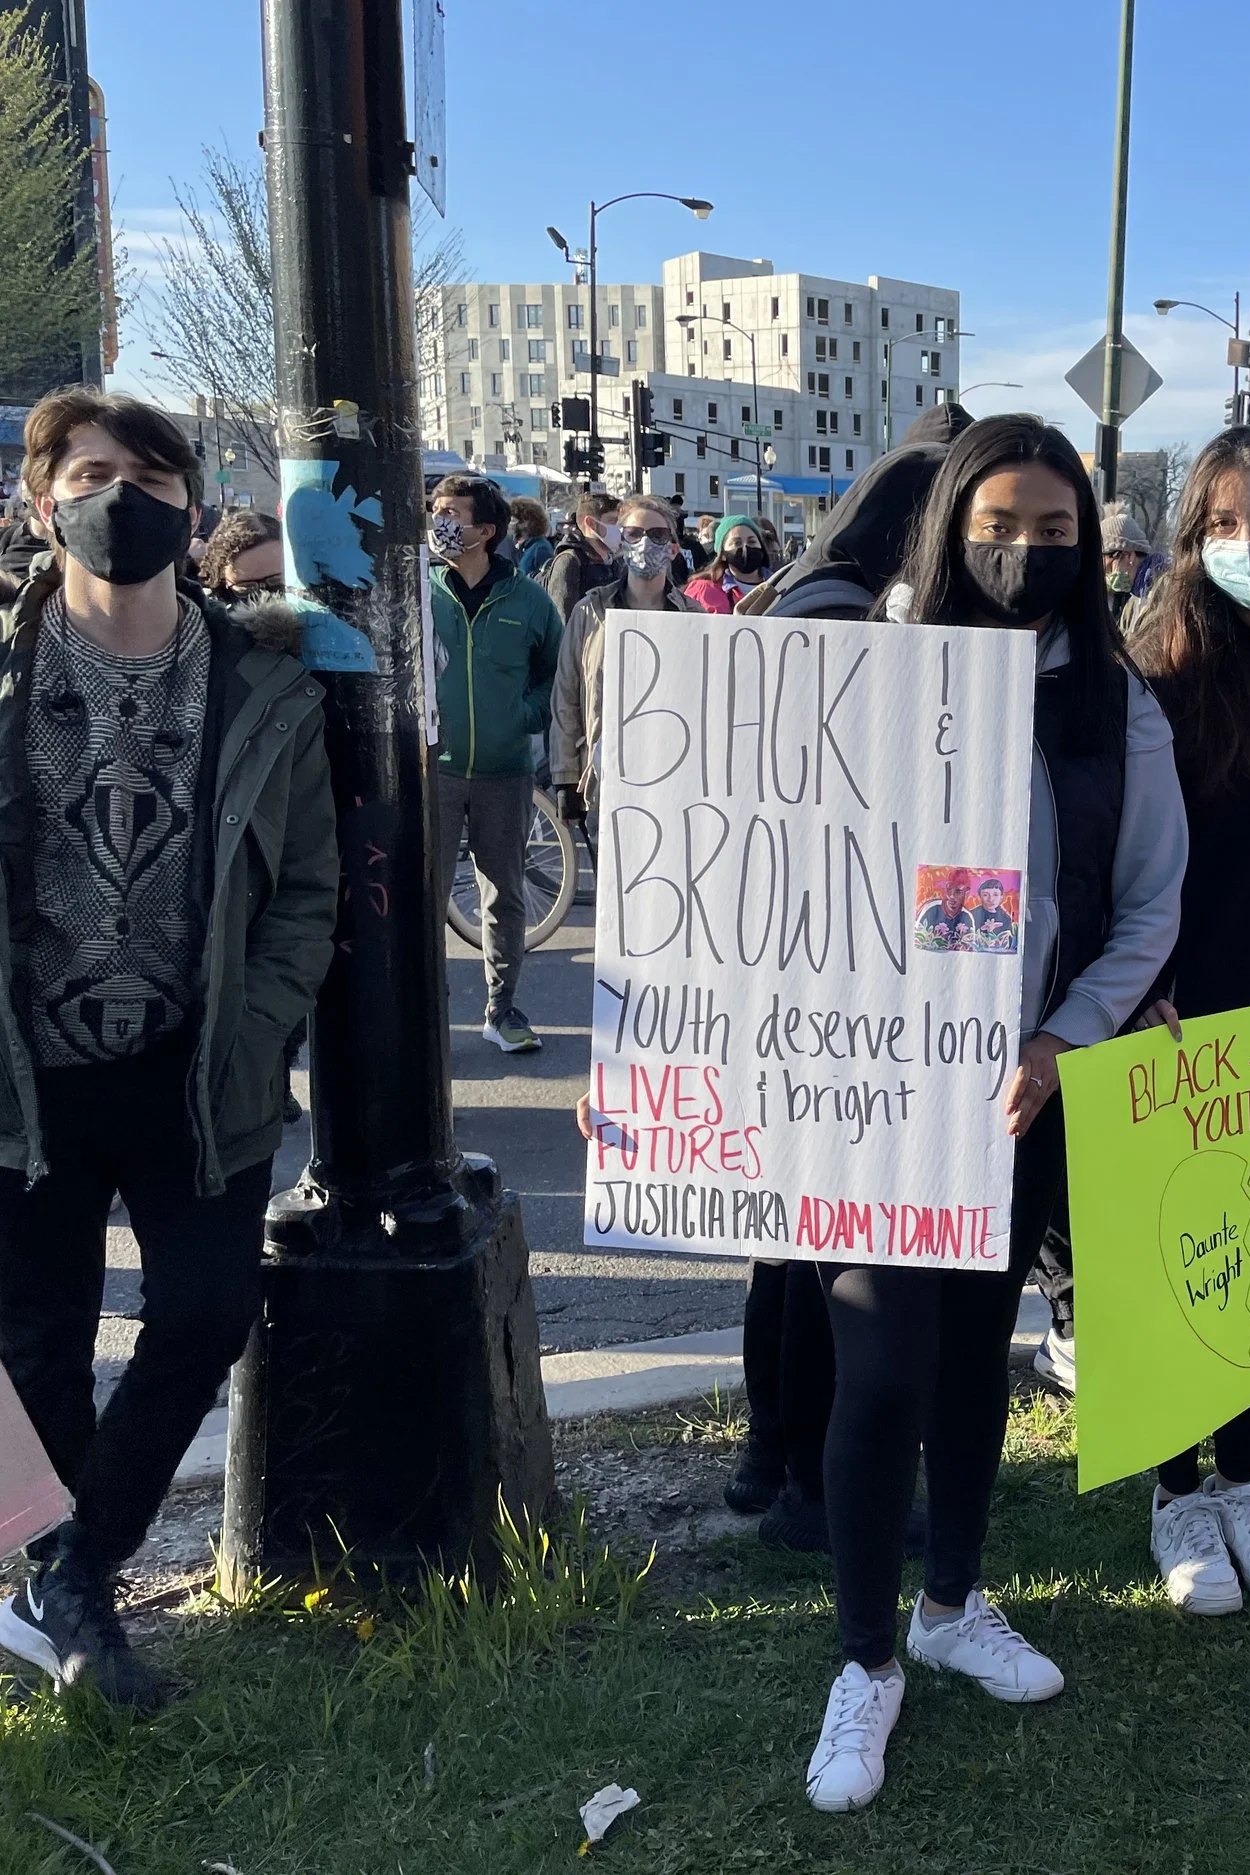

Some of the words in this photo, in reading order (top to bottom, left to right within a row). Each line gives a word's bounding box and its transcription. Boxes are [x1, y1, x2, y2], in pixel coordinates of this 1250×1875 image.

[612, 803, 908, 975] BROWN
[755, 993, 915, 1062] deserve
[924, 1000, 1008, 1101] long
[1129, 1034, 1240, 1124] BLACK
[597, 1062, 723, 1126] LIVES
[783, 1069, 916, 1145] bright
[593, 1180, 725, 1239] JUSTICIA
[731, 1189, 789, 1243] PARA
[796, 1195, 874, 1254] ADAM
[878, 1202, 897, 1257] Y
[900, 1204, 998, 1260] DAUNTE
[1180, 1211, 1239, 1268] Daunte
[1185, 1246, 1243, 1312] Wright
